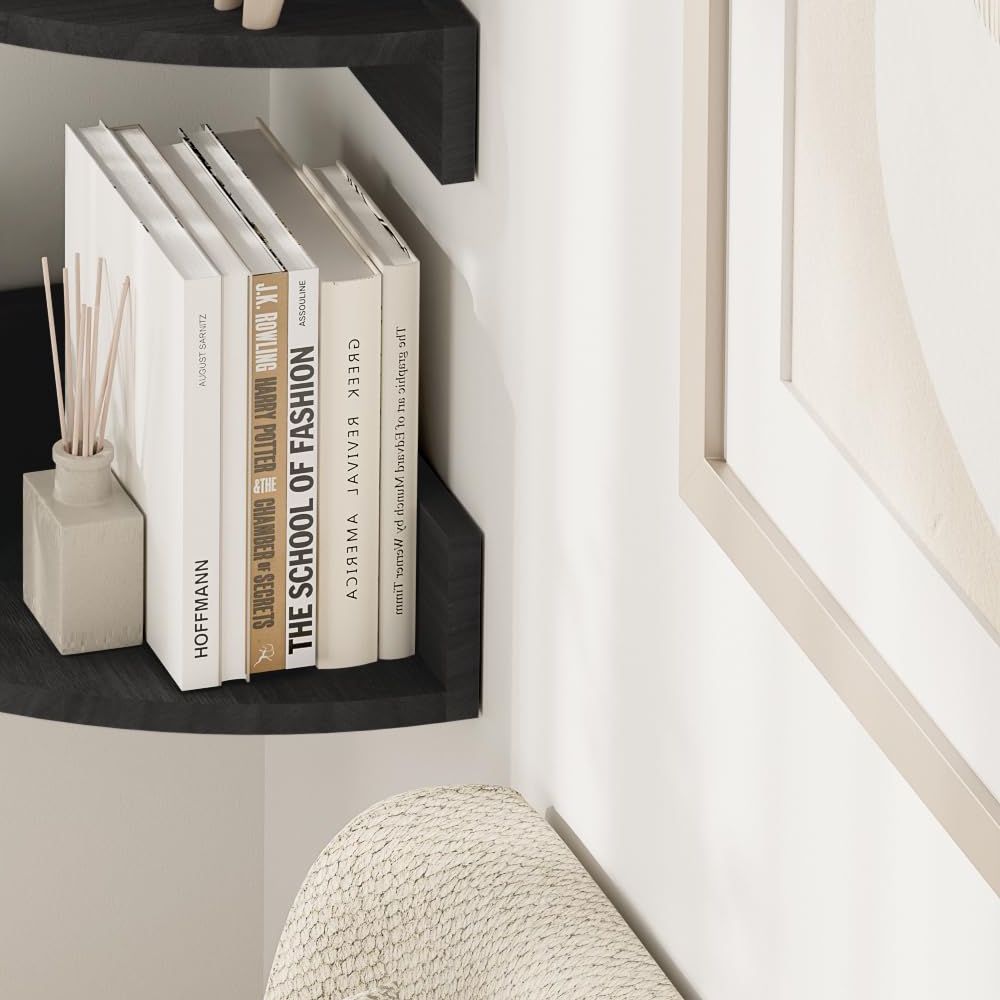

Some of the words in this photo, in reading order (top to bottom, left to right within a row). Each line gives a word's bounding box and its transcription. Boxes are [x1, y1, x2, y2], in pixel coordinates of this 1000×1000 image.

[255, 282, 278, 310] J.K.
[298, 280, 307, 327] ASSOULINE
[198, 313, 207, 350] SARNITZ
[255, 311, 278, 373] ROWLING
[198, 351, 207, 387] AUGUST
[254, 376, 277, 420] HARRY
[289, 346, 315, 456] FASHION
[253, 423, 277, 473] POTTER
[289, 461, 314, 492] OF
[252, 498, 276, 561] CHAMBER
[289, 497, 314, 598] SCHOOL
[194, 559, 209, 659] HOFFMANN
[252, 573, 275, 630] SECRETS
[289, 604, 313, 655] THE
